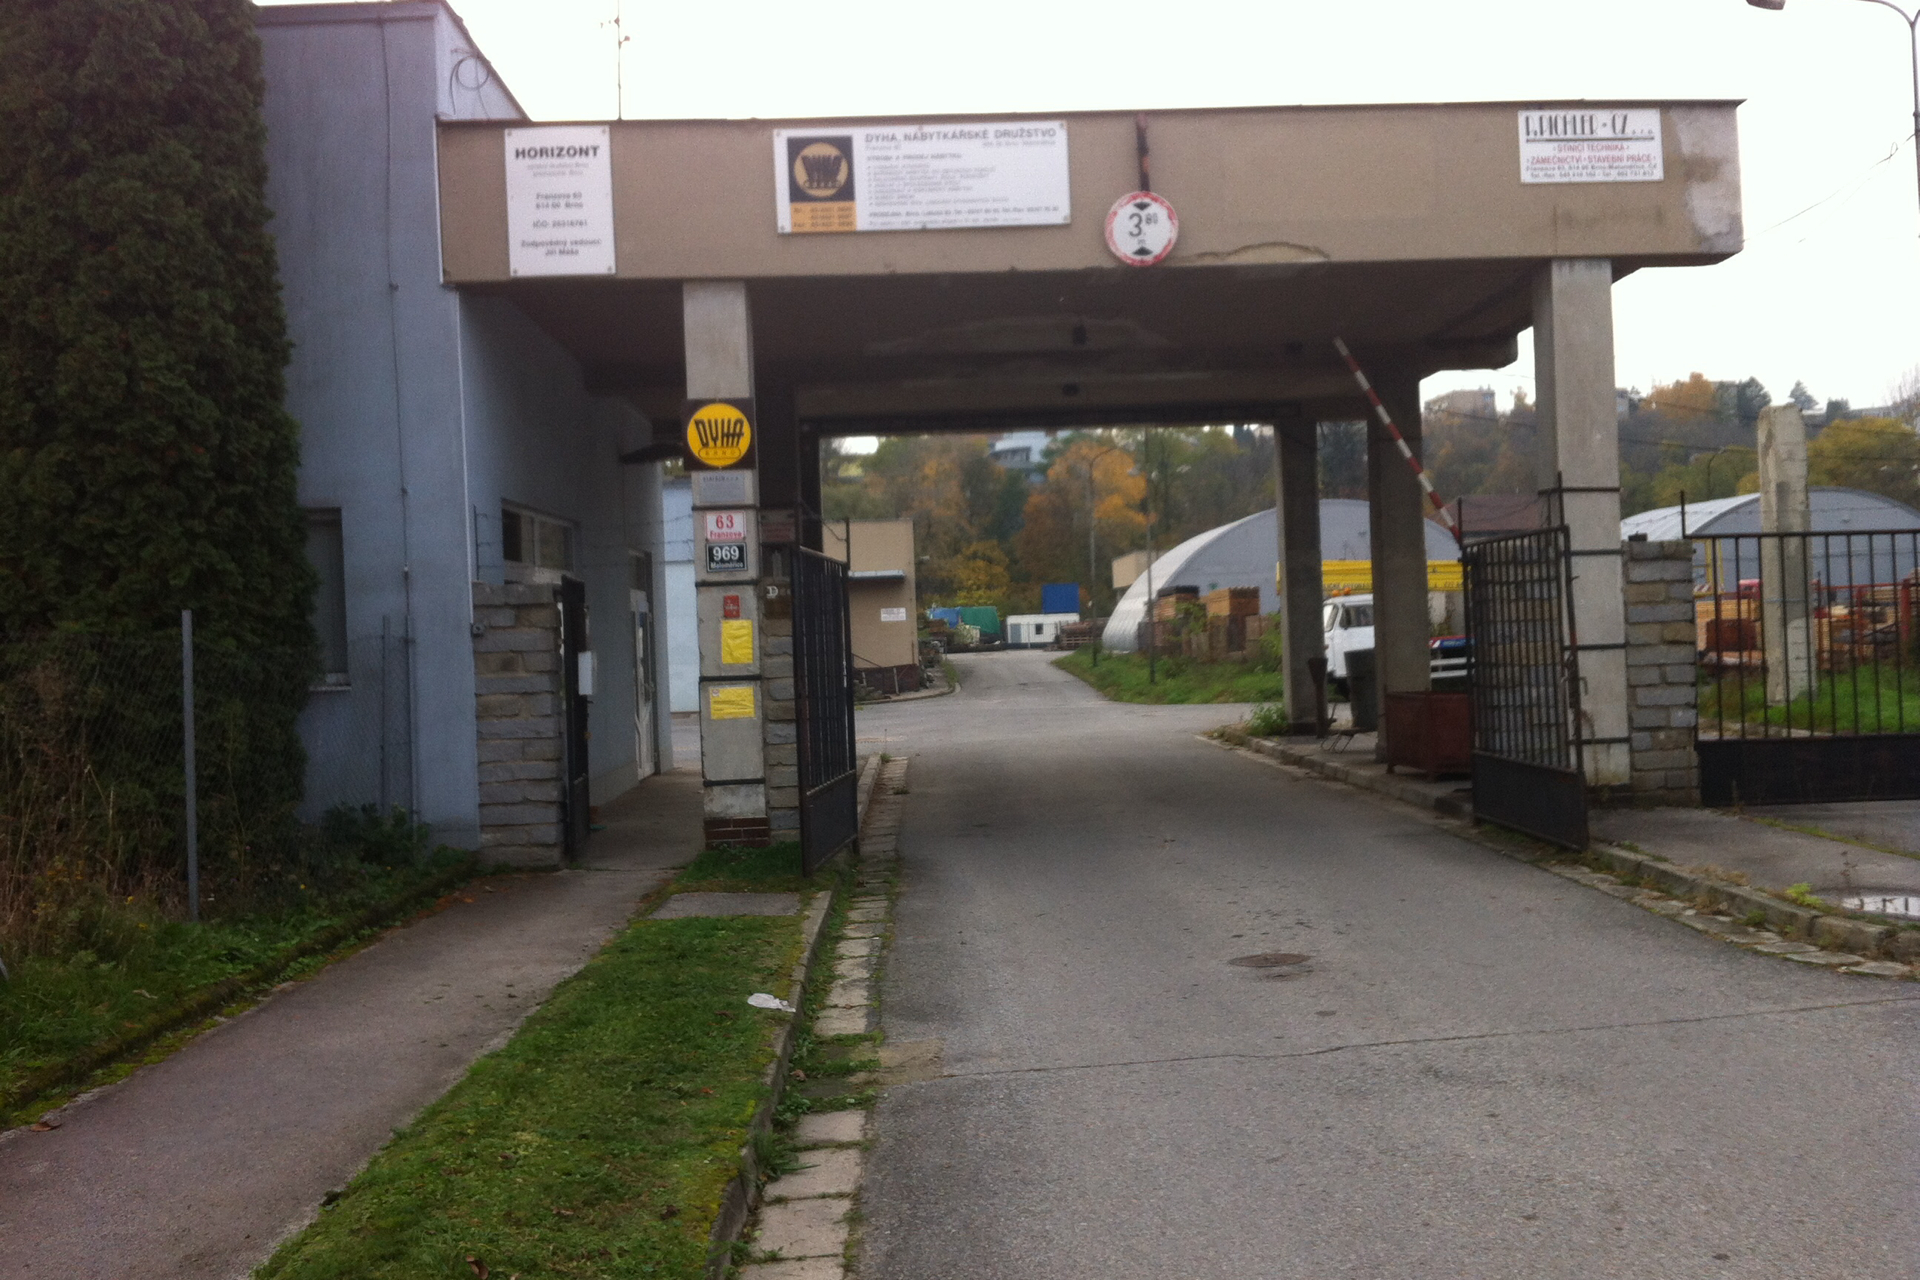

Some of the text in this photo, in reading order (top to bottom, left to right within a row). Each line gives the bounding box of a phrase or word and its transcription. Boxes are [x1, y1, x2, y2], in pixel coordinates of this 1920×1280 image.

[993, 127, 1057, 140] DRUŽSTVO
[515, 145, 600, 159] HORIZONT
[1129, 212, 1143, 238] 3
[694, 417, 745, 448] DYHA
[715, 514, 735, 529] 63
[709, 530, 742, 539] Franzova
[712, 545, 740, 561] 969
